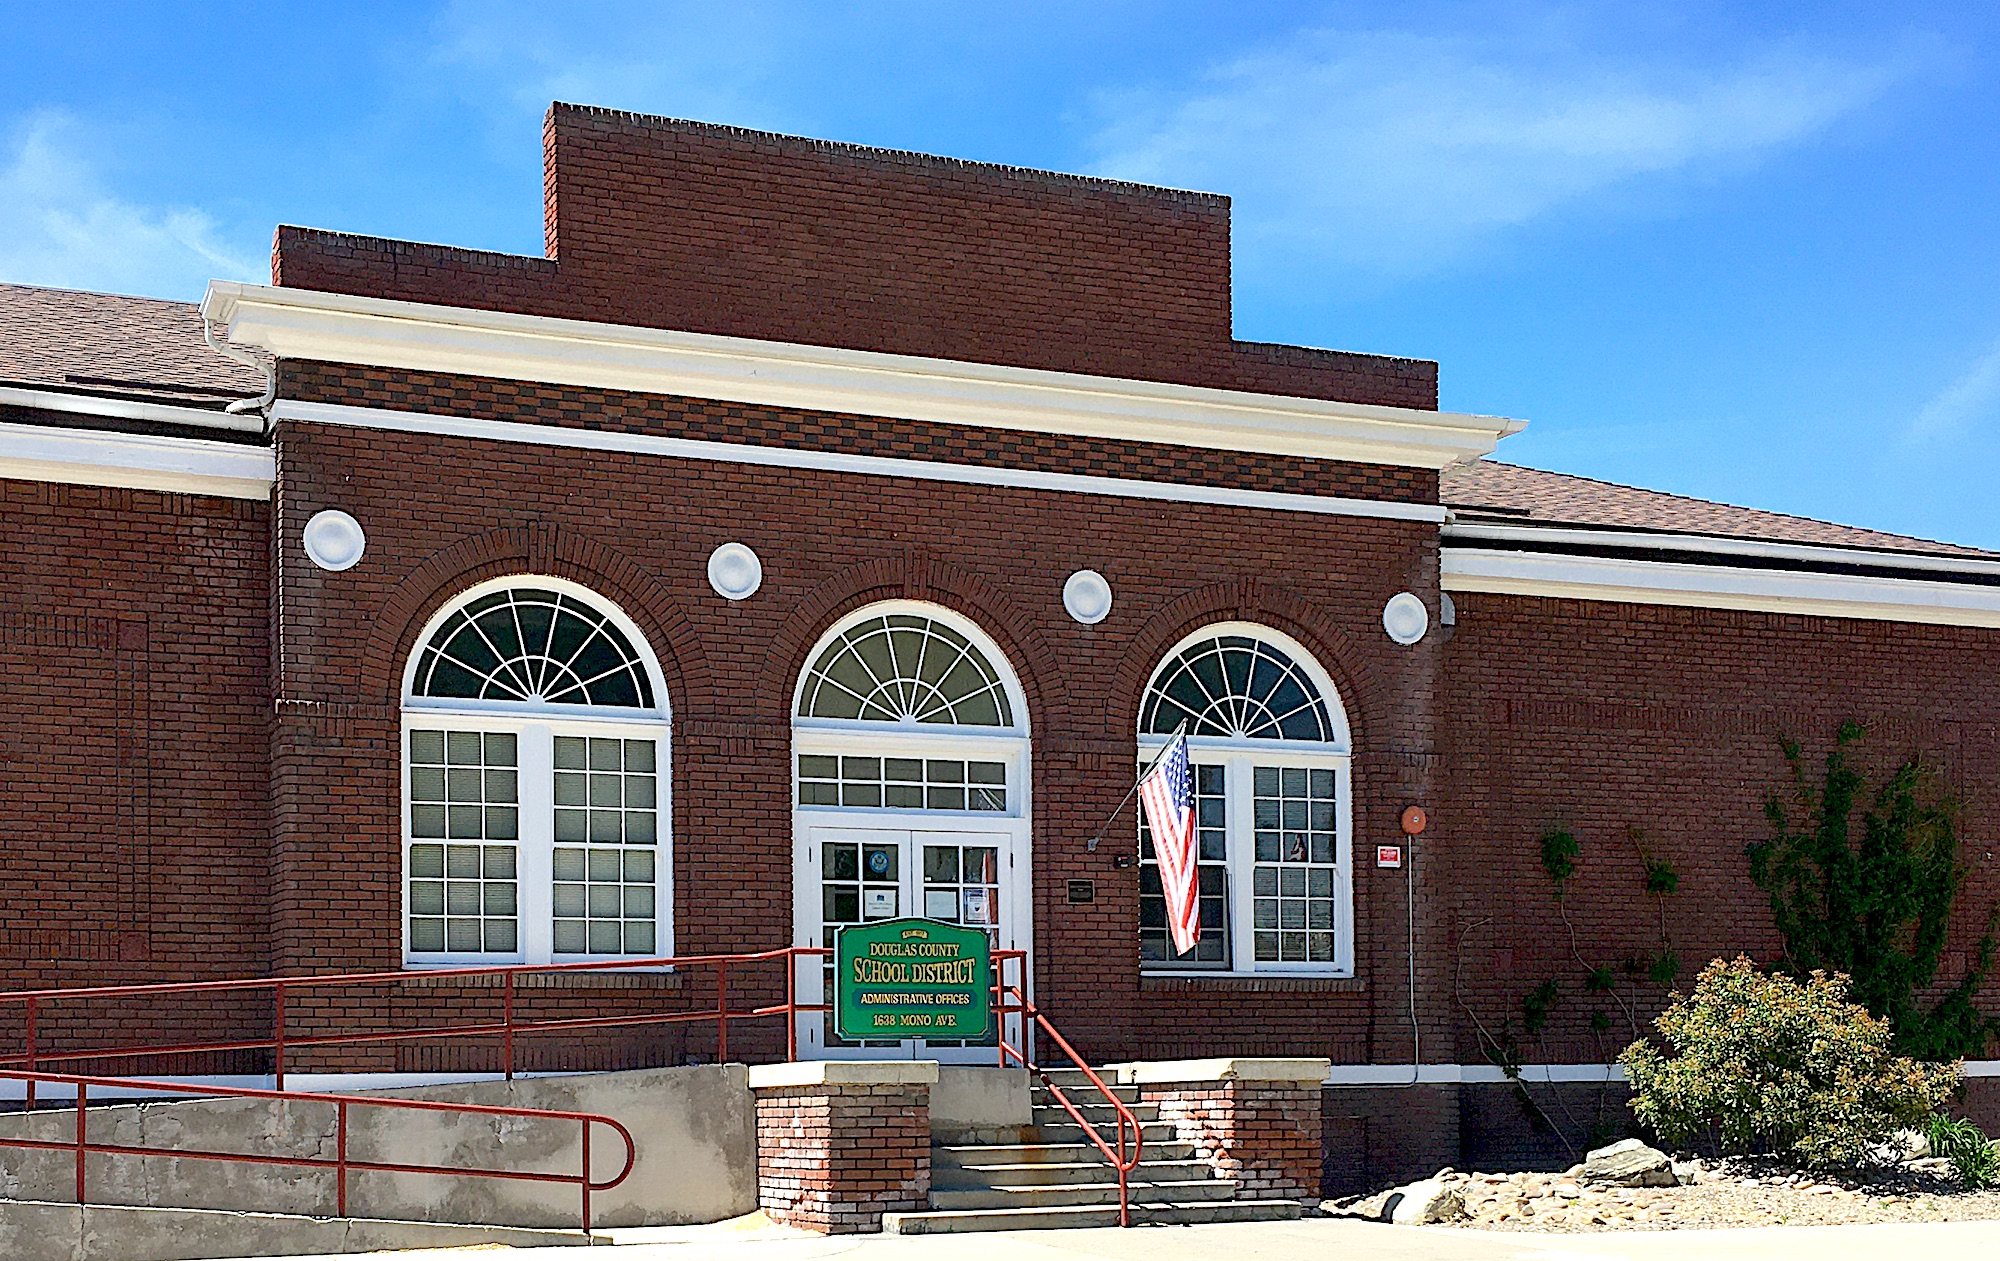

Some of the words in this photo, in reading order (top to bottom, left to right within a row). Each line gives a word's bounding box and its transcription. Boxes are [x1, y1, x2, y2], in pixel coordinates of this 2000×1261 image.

[870, 943, 917, 956] DOUGLAS
[919, 943, 959, 956] COUNTY
[853, 958, 910, 983] SCHOOL
[912, 958, 976, 984] DISTRICT
[860, 993, 934, 1004] ADMINISTRATIVE
[935, 993, 970, 1005] OFFICES
[873, 1014, 896, 1026] 1638
[900, 1014, 931, 1026] MONO
[935, 1014, 957, 1026] AVE.
